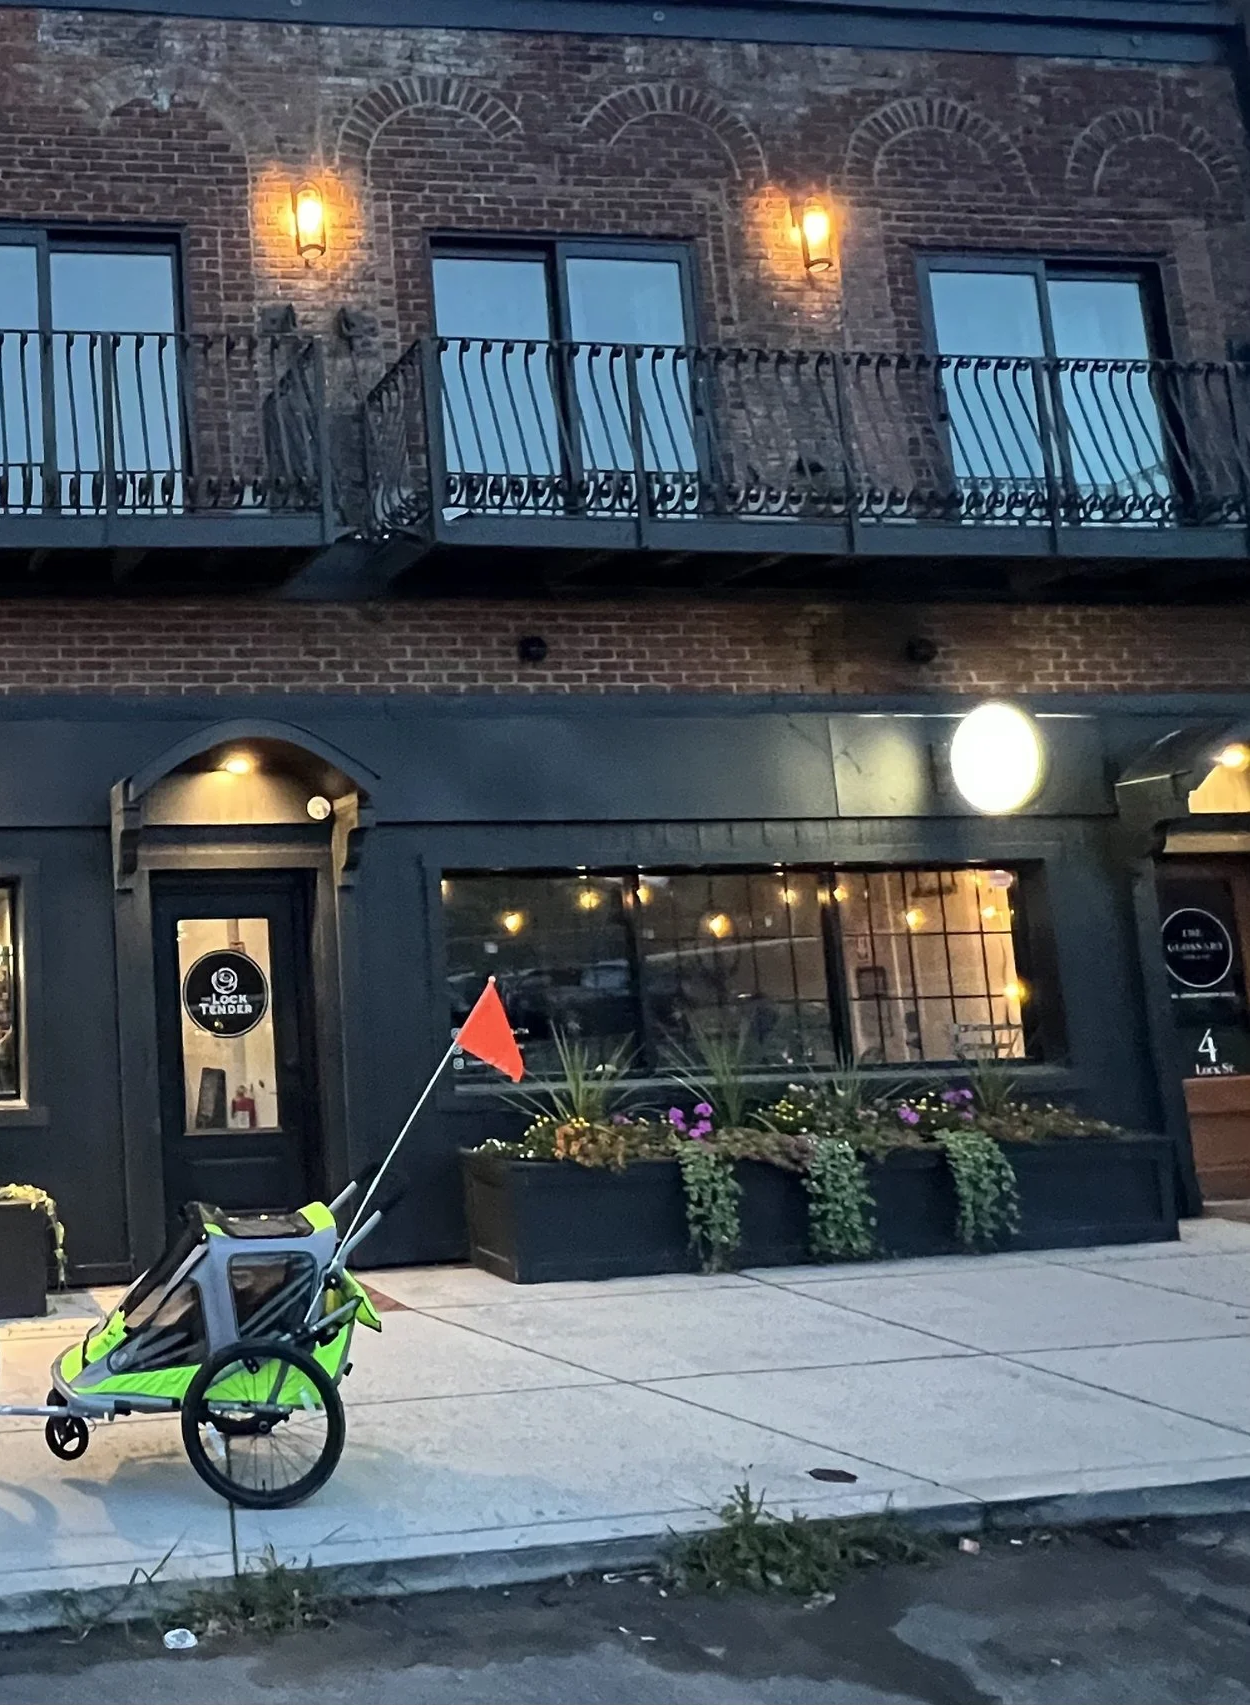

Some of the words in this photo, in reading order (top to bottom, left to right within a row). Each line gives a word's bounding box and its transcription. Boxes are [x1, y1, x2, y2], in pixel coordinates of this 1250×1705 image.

[211, 993, 248, 1005] LOCK
[198, 1003, 253, 1015] TENDER
[1198, 1028, 1218, 1062] 4
